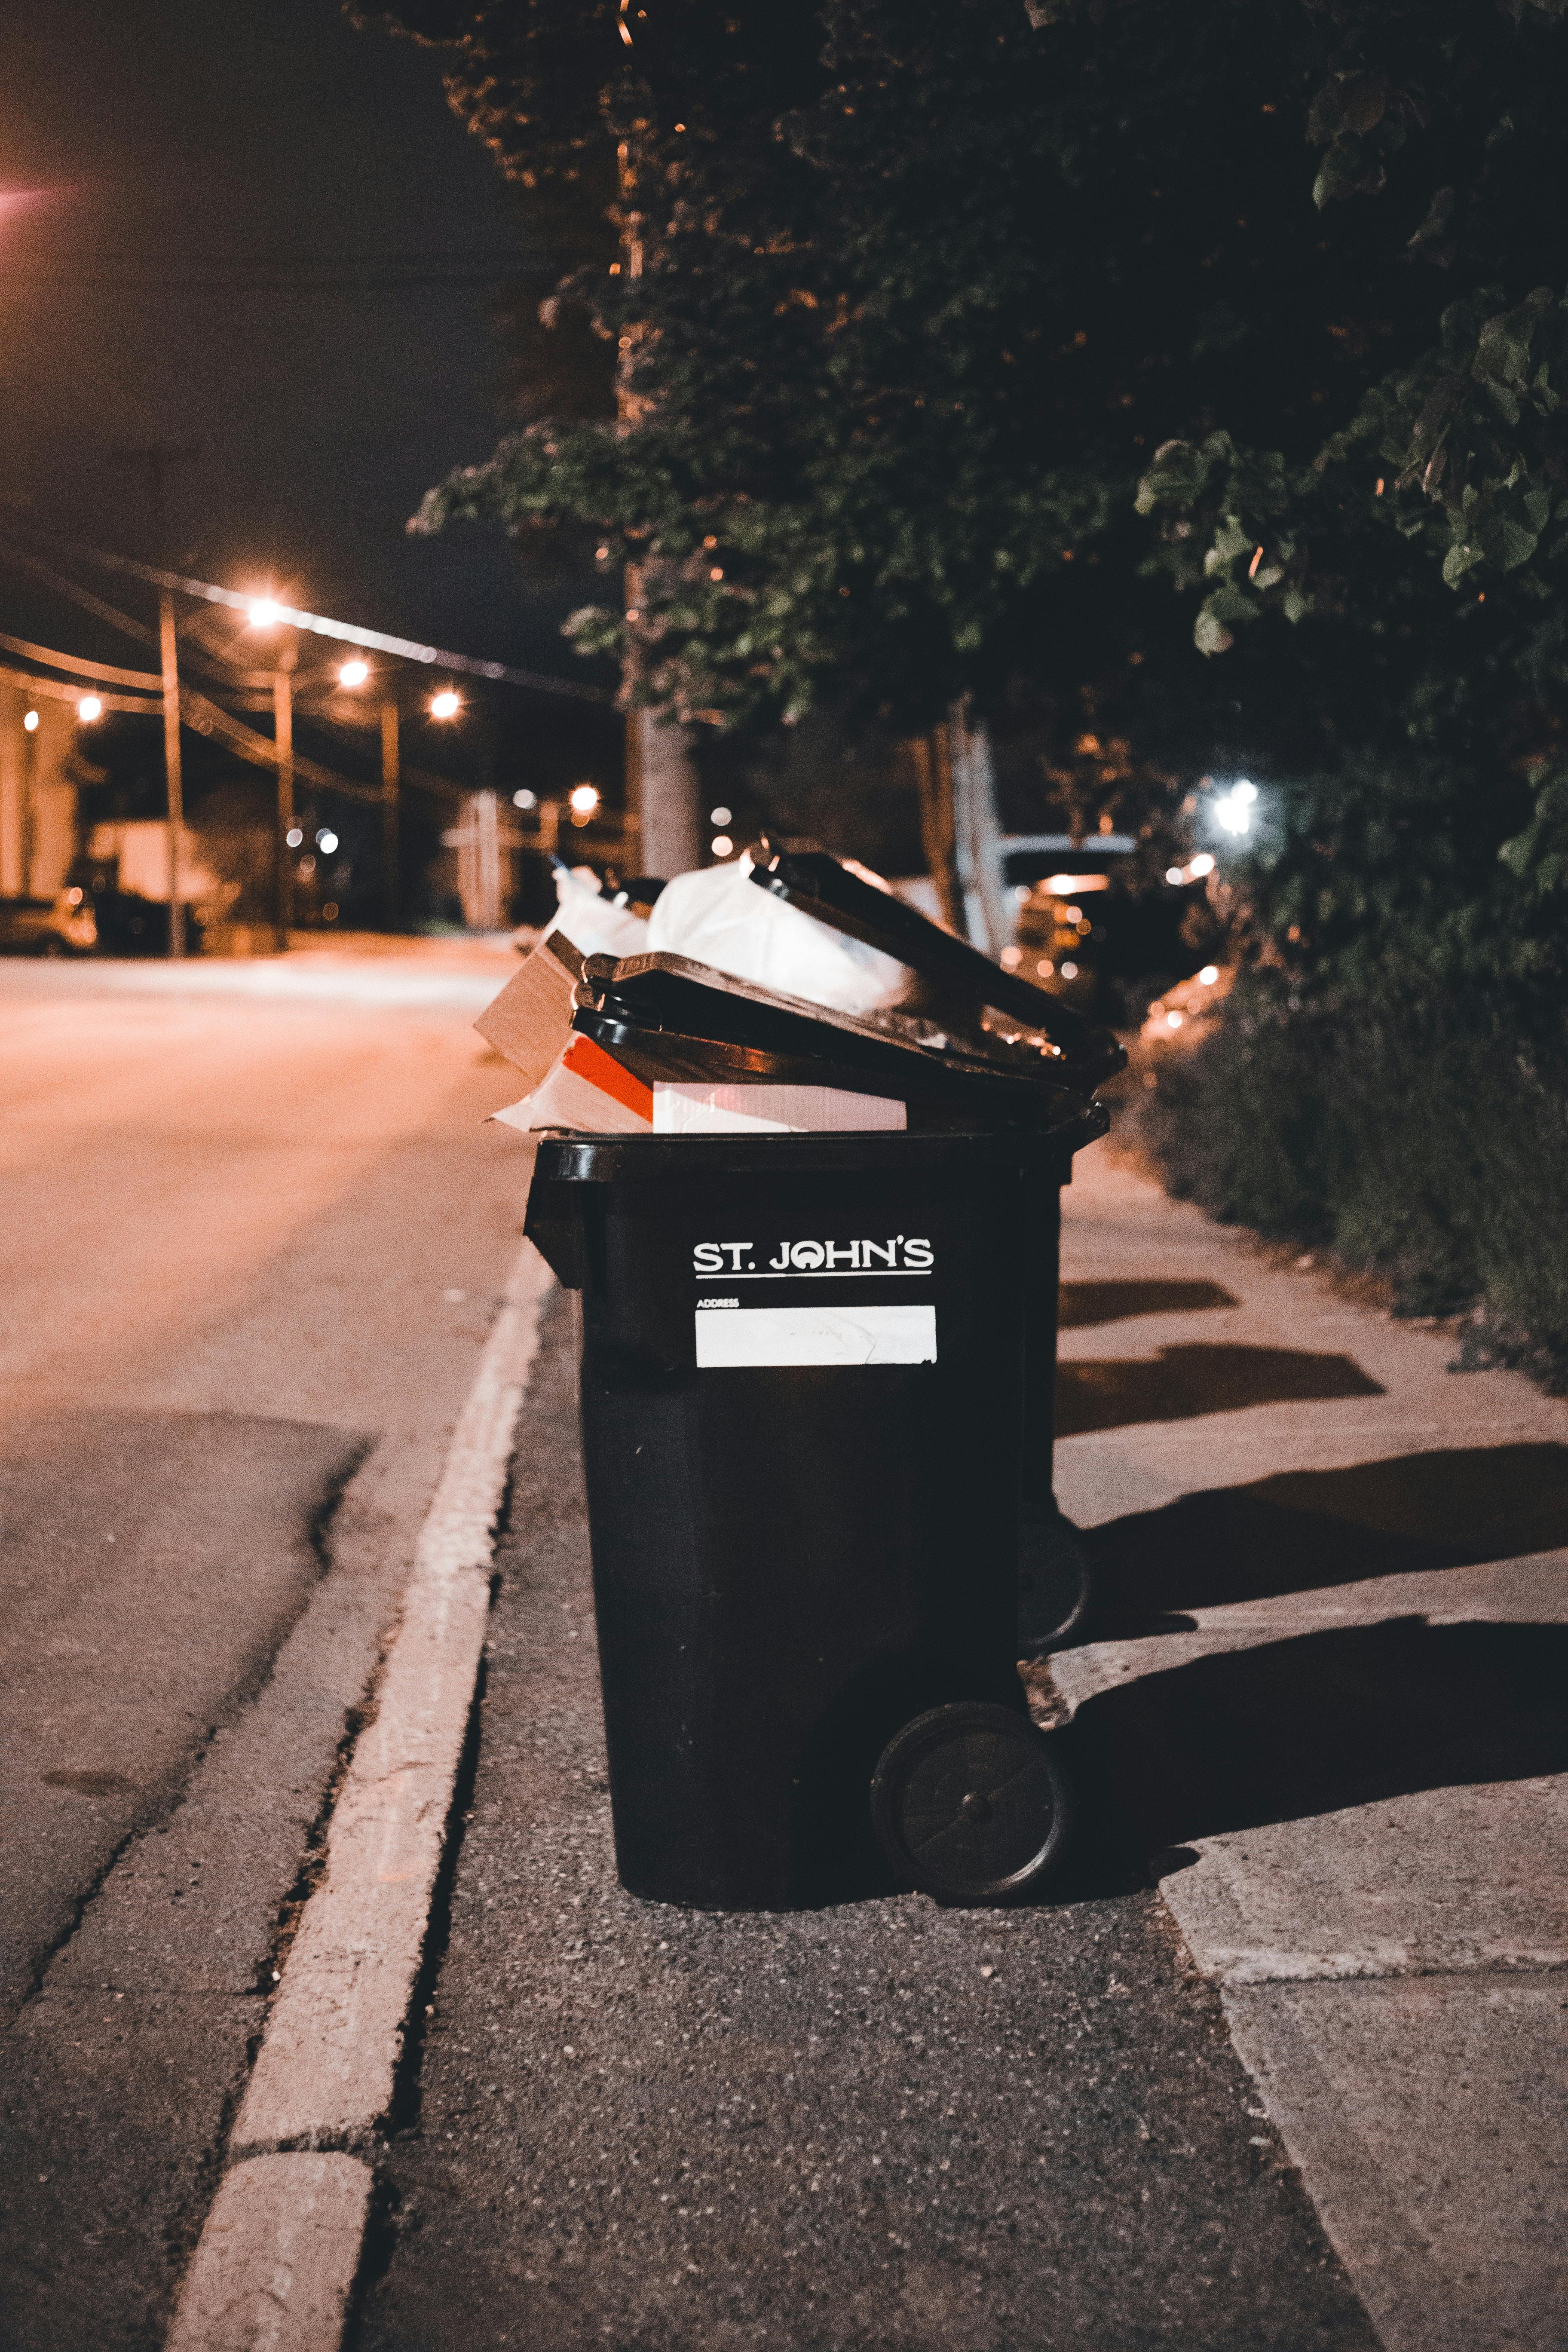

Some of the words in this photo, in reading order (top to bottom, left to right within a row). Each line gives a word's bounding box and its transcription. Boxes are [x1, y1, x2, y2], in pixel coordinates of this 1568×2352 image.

[693, 1242, 756, 1271] ST.
[769, 1235, 934, 1270] JOHN'S
[697, 1298, 740, 1308] ADDRESS
